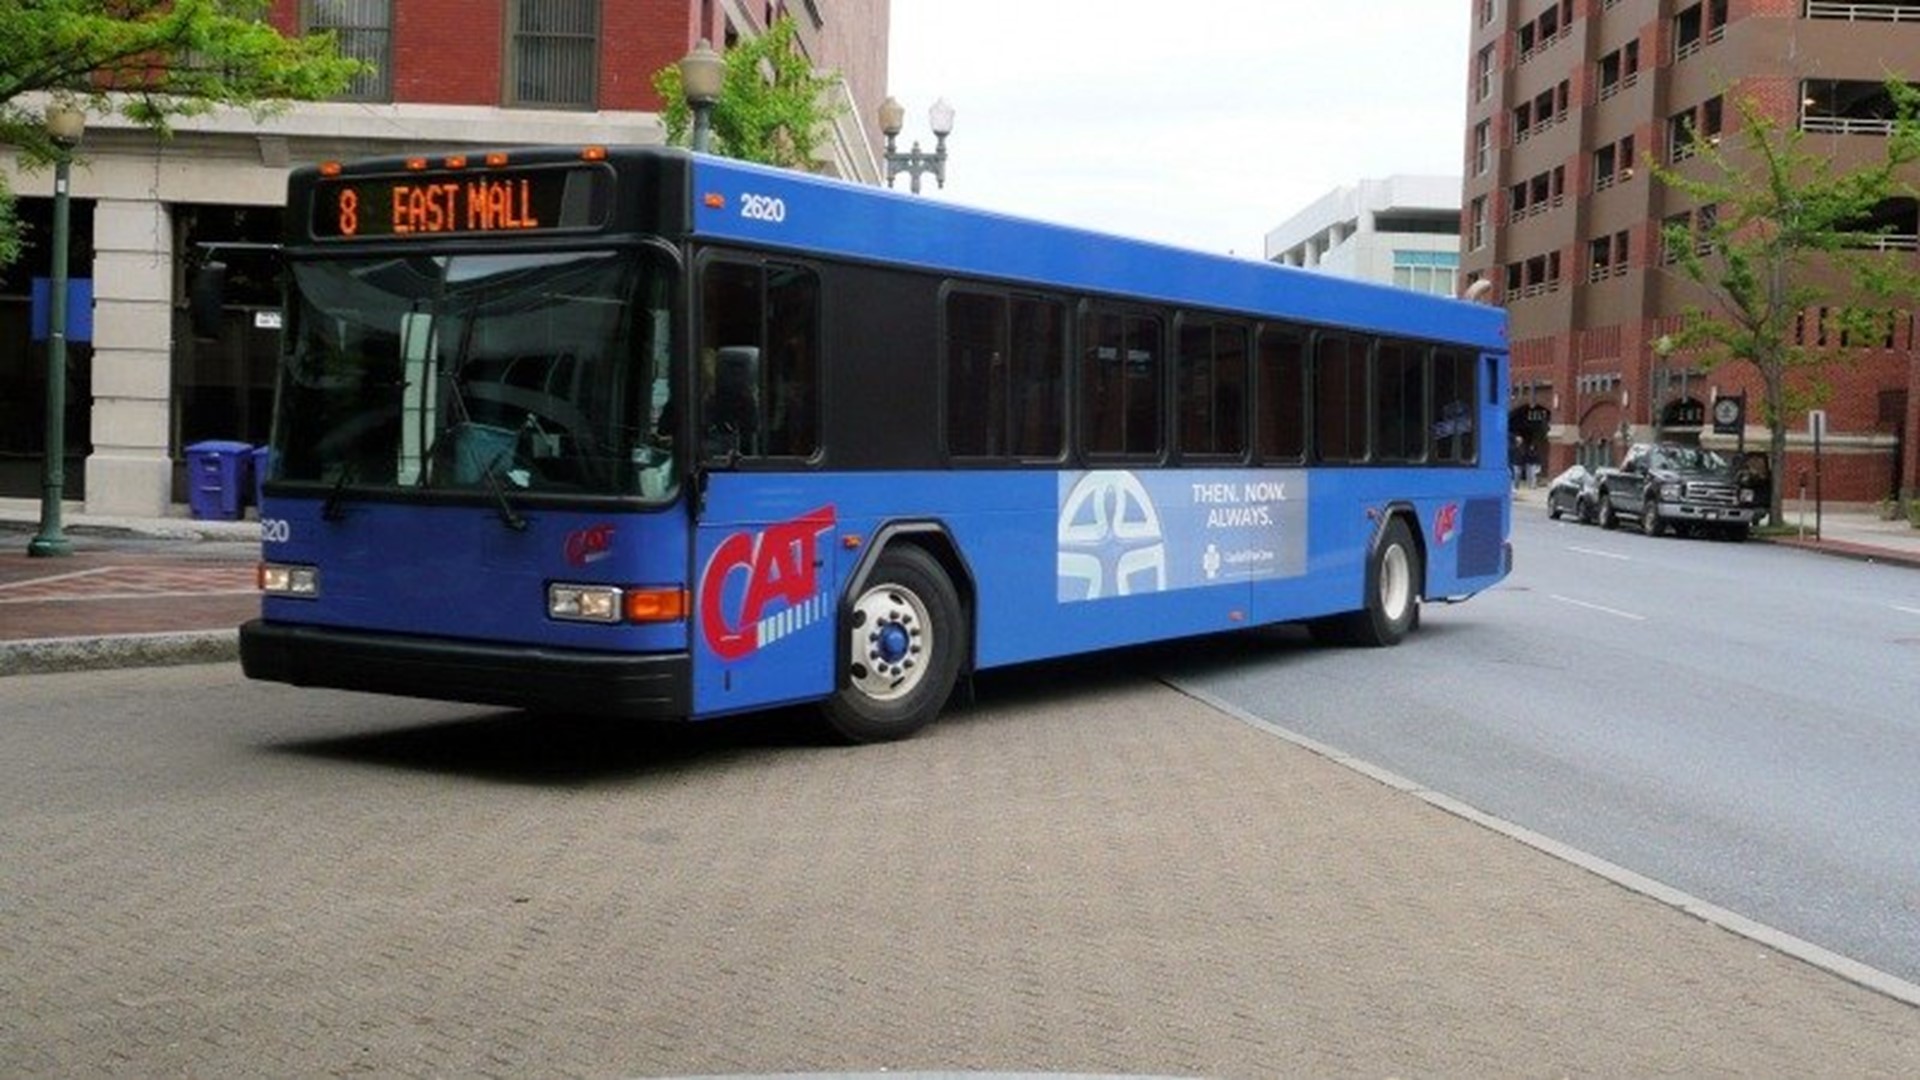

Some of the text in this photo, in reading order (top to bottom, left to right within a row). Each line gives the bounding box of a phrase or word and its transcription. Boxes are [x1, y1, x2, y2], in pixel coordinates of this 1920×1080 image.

[339, 178, 539, 235] 8 EAST MALL
[741, 193, 785, 222] 2620
[1192, 482, 1287, 503] THEN. NOW.
[1206, 506, 1273, 528] ALWAYS.
[697, 502, 837, 662] CAT
